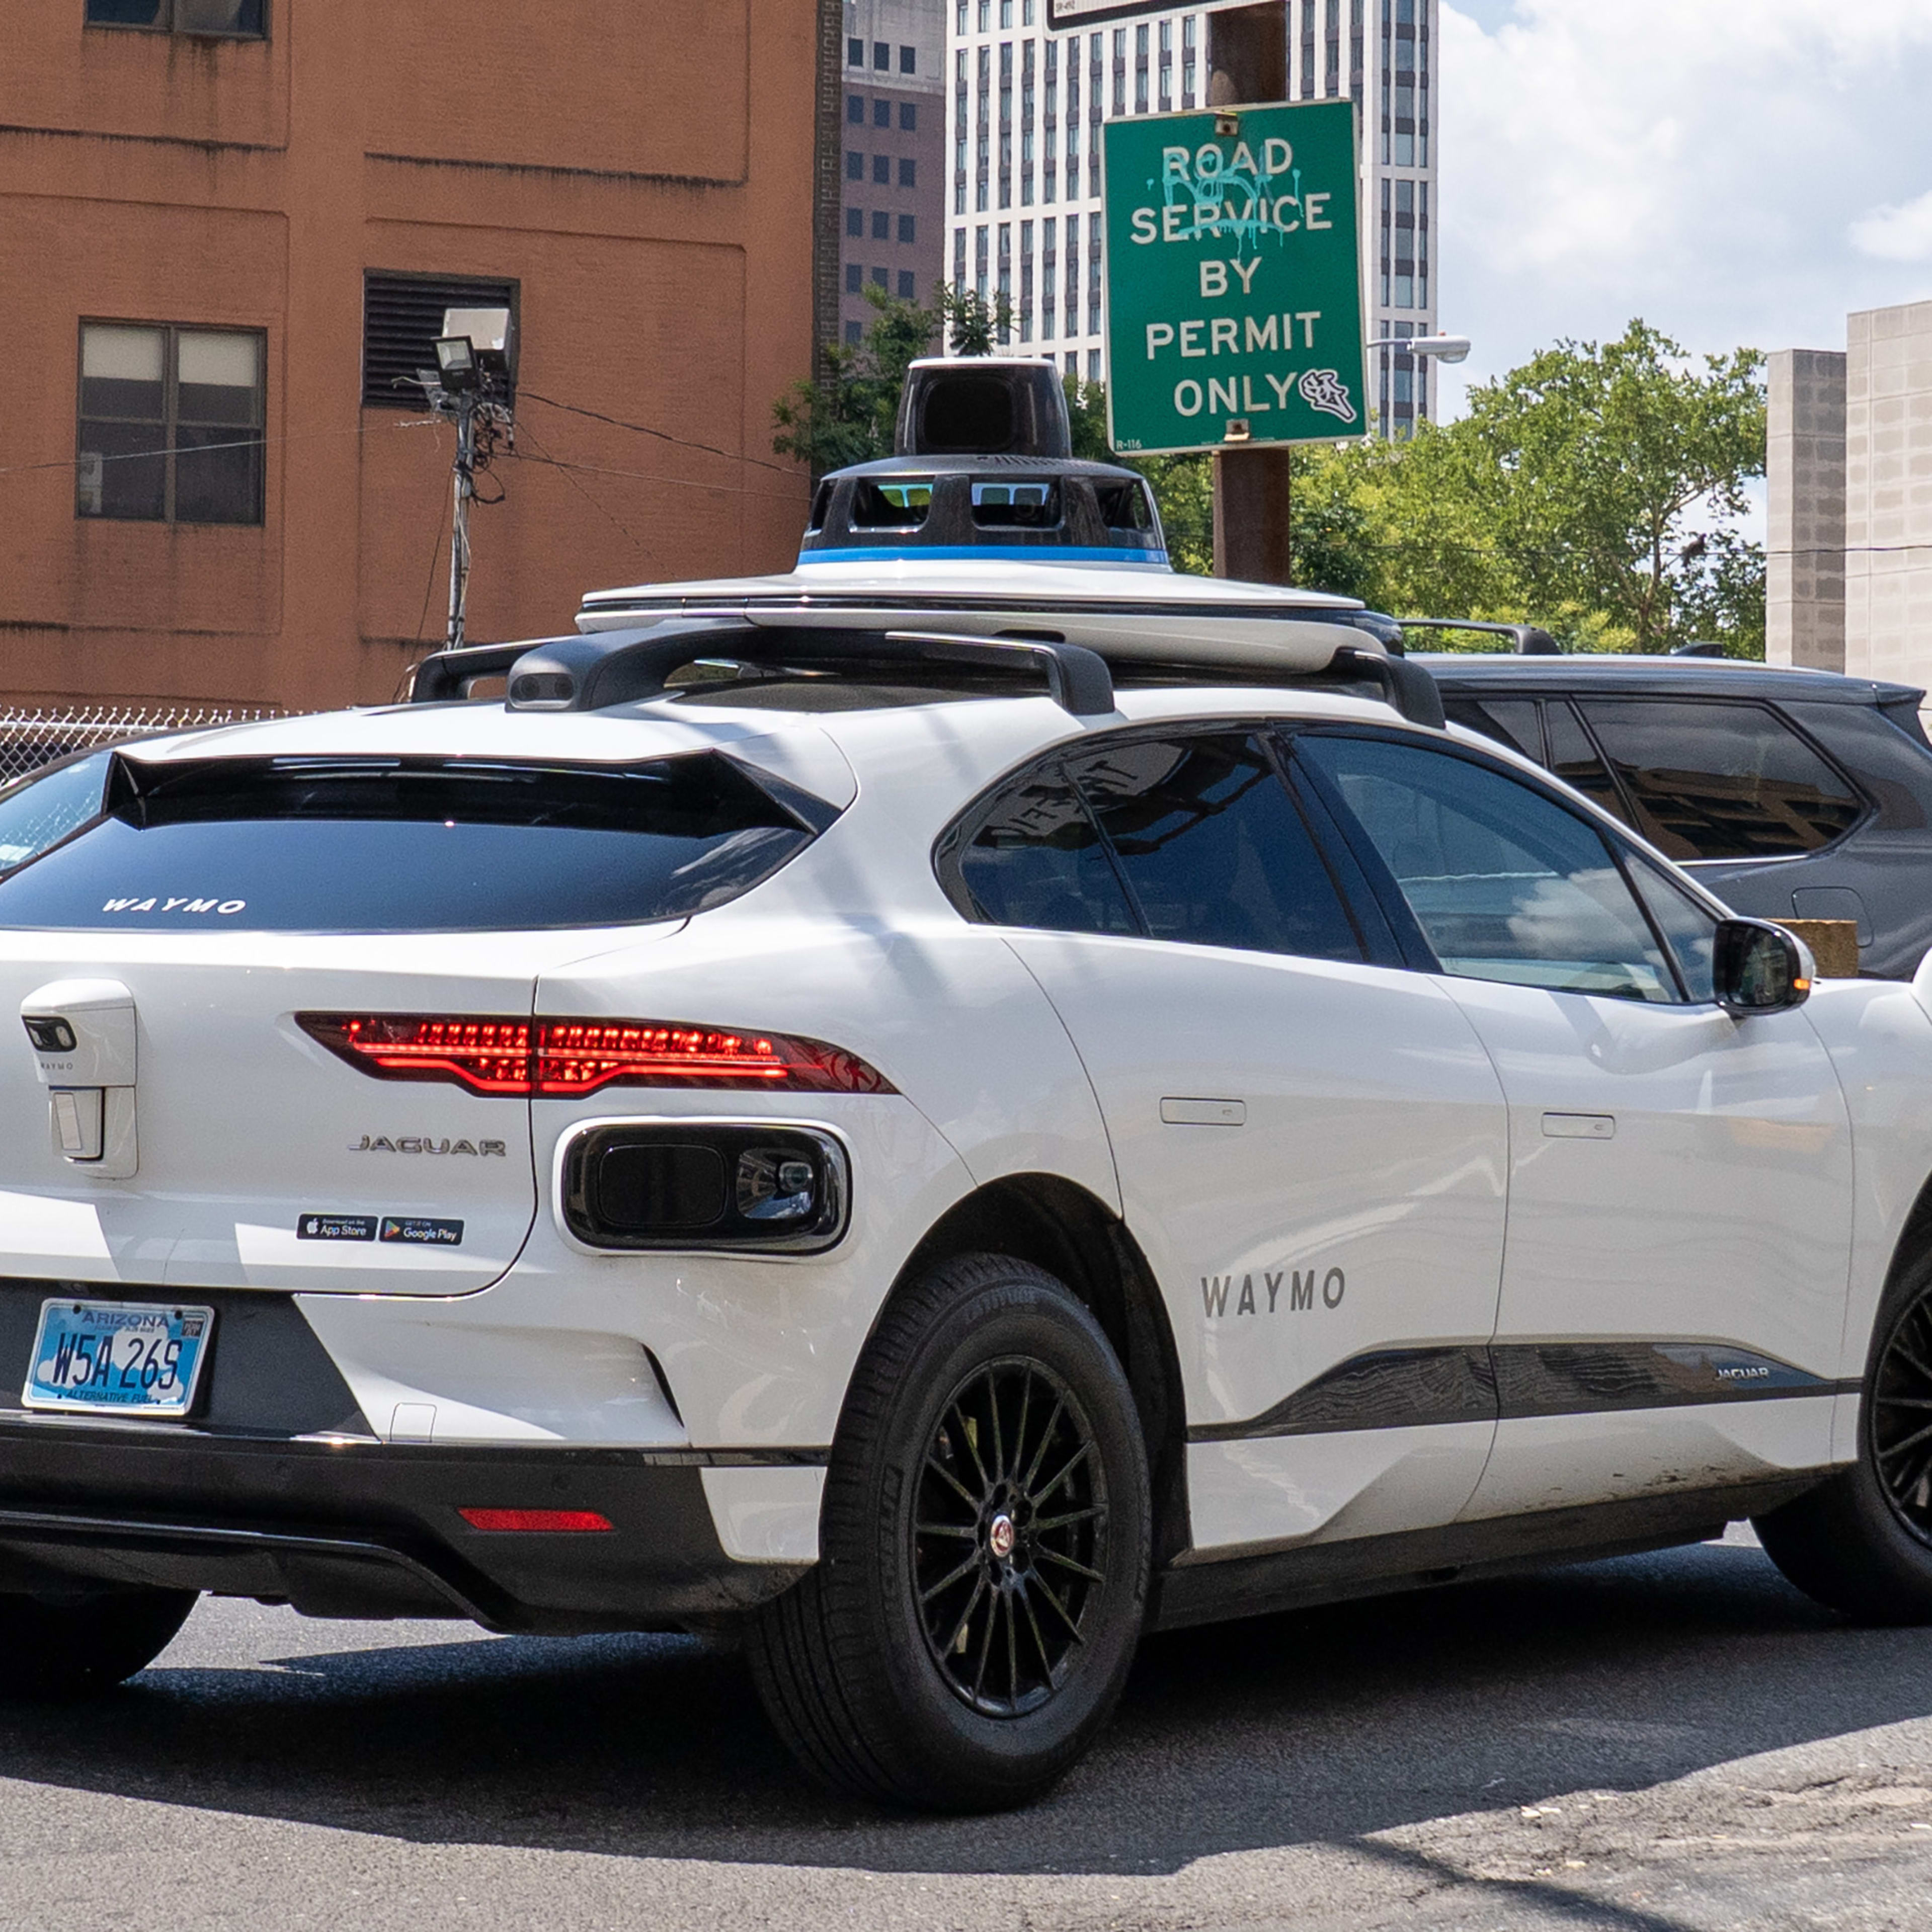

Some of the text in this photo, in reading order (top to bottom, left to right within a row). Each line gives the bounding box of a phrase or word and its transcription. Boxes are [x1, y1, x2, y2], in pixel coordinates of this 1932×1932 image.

[1163, 138, 1293, 181] ROAD
[1130, 193, 1332, 245] SERVICE
[1199, 257, 1262, 297] BY
[1146, 311, 1321, 360] PERMIT
[1174, 372, 1298, 416] ONLY
[1116, 439, 1142, 450] R-116
[102, 898, 246, 914] WAYMO
[347, 1135, 506, 1157] JAGUAR
[320, 1225, 366, 1236] App Store
[403, 1227, 457, 1242] Google Play
[1201, 1267, 1345, 1318] WAYMO
[82, 1312, 169, 1327] ARIZONA
[52, 1332, 183, 1390] W5A 26S
[1714, 1367, 1769, 1381] JAGUAR
[66, 1390, 152, 1403] ALTERNATIVE FUEL
